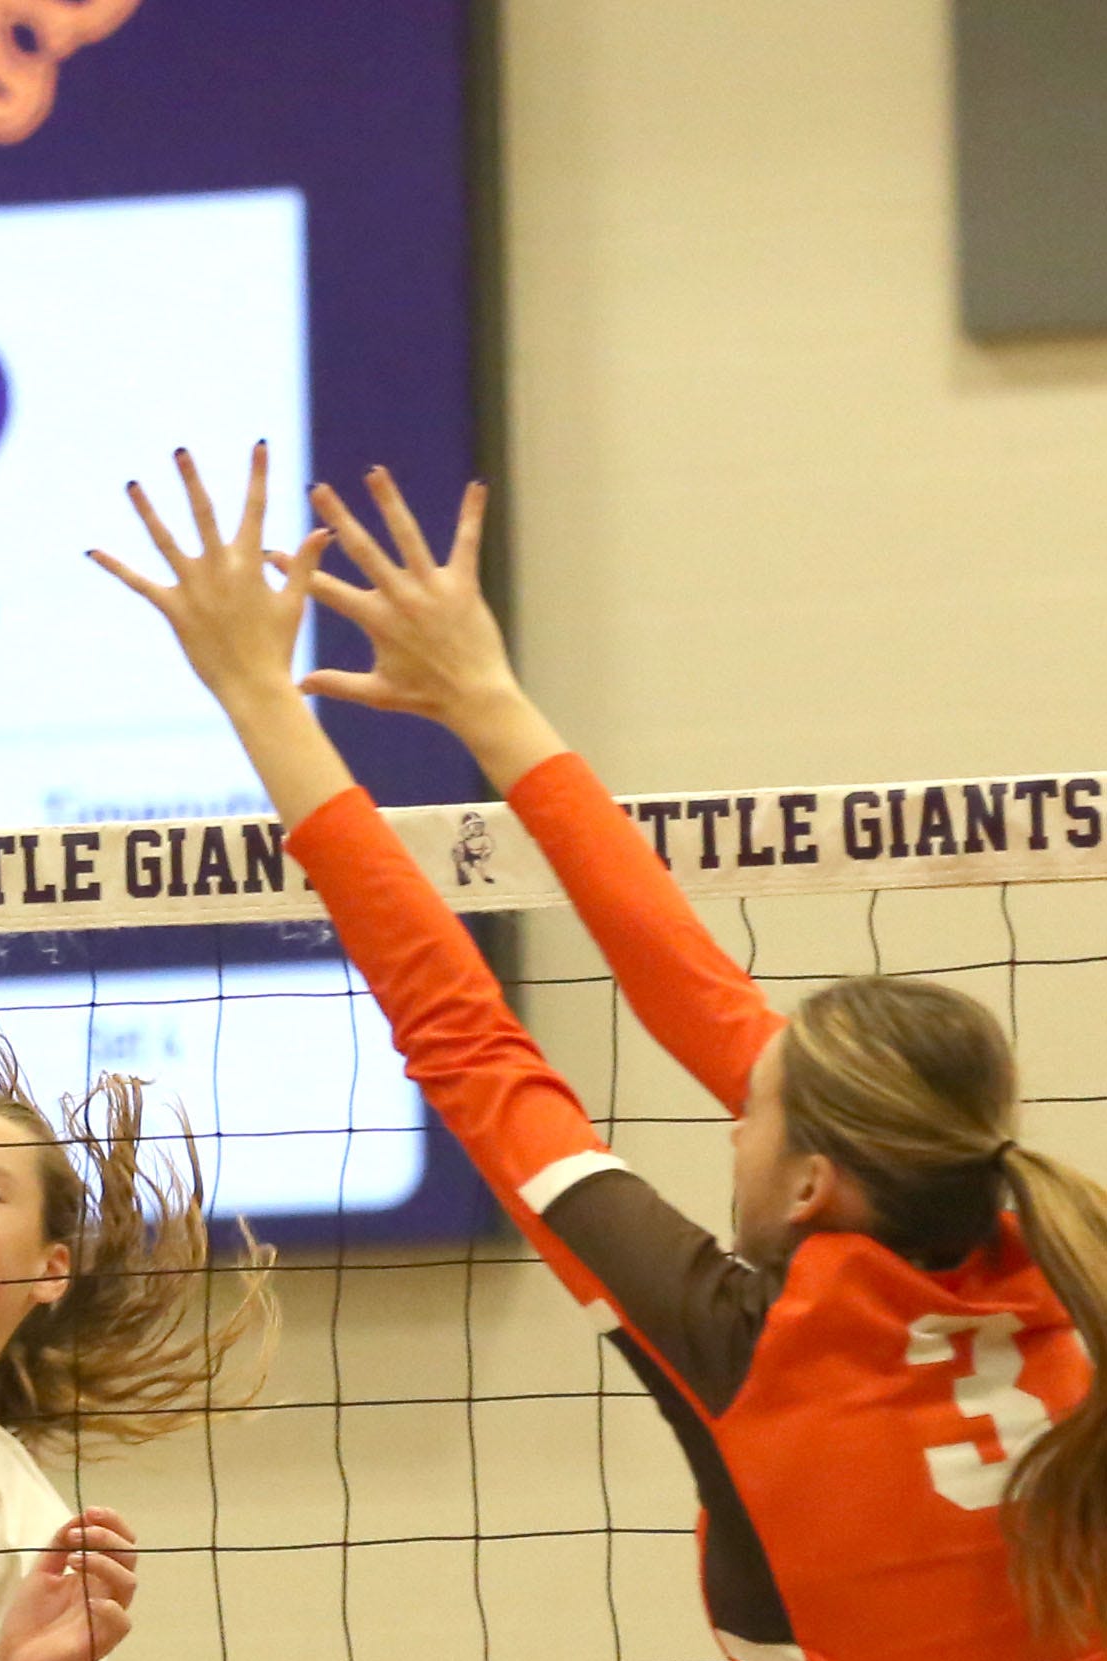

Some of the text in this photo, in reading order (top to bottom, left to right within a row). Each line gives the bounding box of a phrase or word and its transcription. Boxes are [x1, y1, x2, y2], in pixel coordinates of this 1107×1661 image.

[125, 822, 314, 898] GIAN
[616, 778, 1102, 871] TTLE GIANTS
[904, 1312, 1053, 1511] 3
